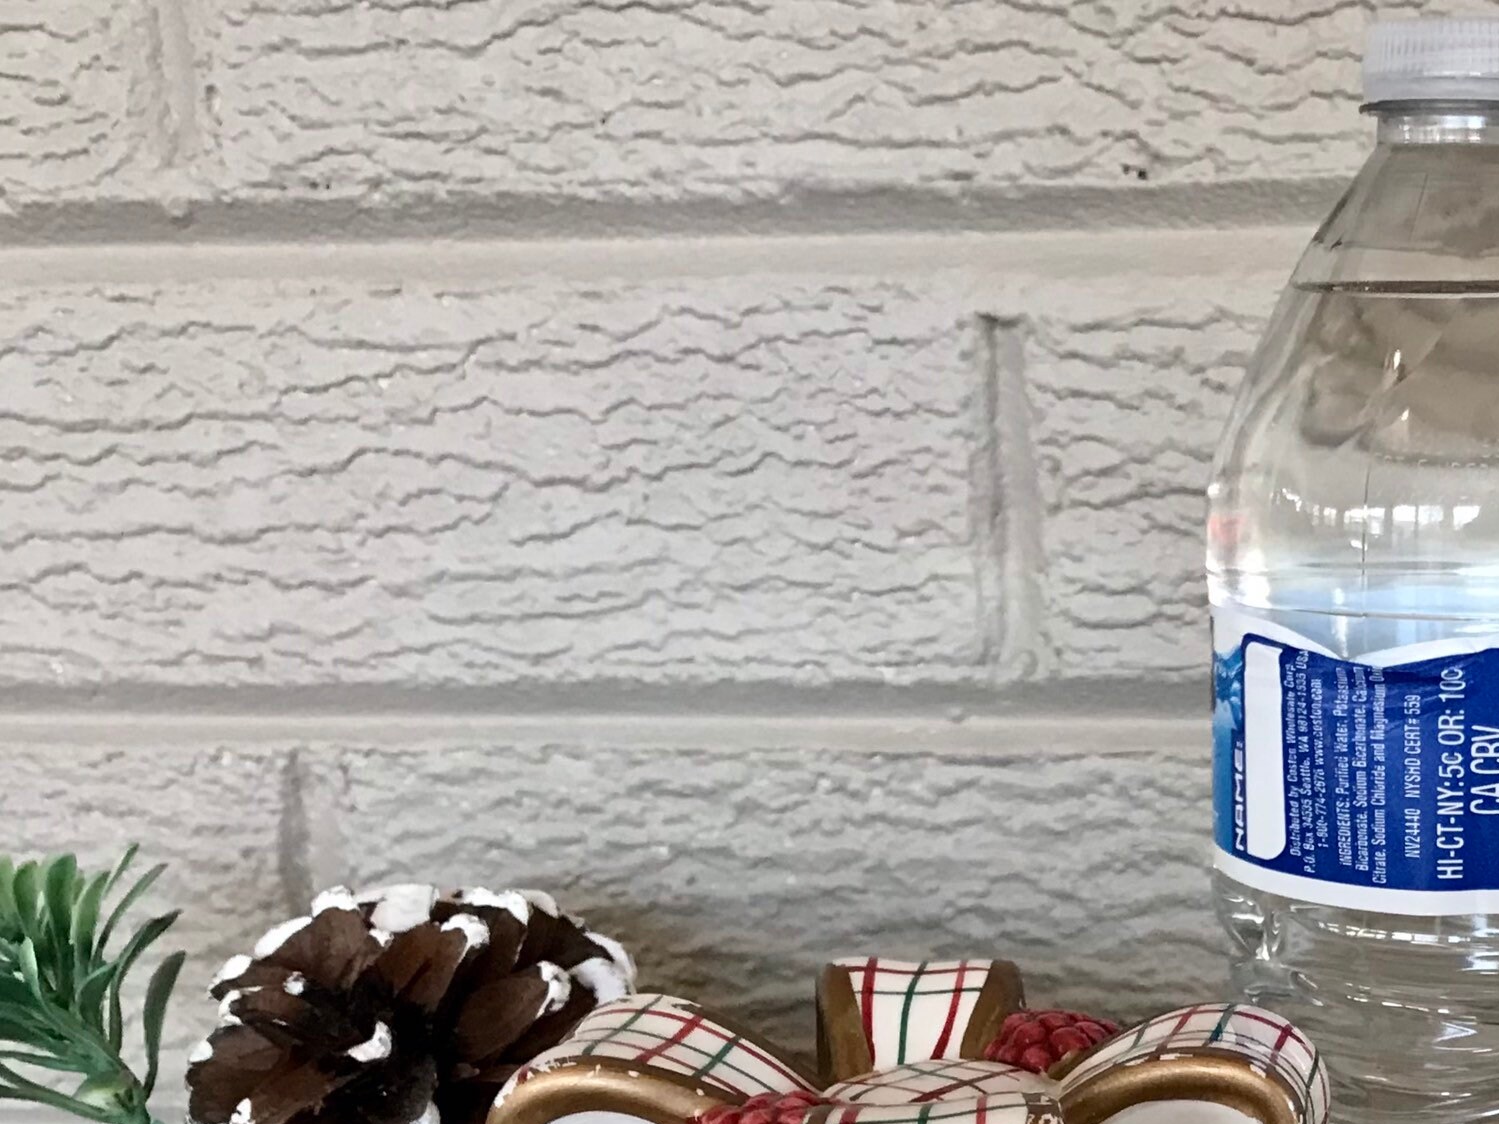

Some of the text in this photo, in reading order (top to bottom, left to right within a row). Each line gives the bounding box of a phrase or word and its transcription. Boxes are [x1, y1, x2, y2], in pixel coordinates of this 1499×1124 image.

[1332, 667, 1349, 717] Potassium
[1370, 683, 1388, 740] Magnesium
[1285, 691, 1296, 744] Wholesale
[1438, 710, 1465, 746] OR:
[1298, 736, 1309, 753] WA
[1370, 743, 1385, 762] and
[1288, 785, 1300, 798] by
[1334, 756, 1350, 795] Purified
[1352, 770, 1368, 808] Sodium
[1370, 764, 1386, 806] Chloride
[1404, 694, 1420, 858] NV24440 NYSHD CERT# 559
[1234, 742, 1244, 851] NAME:
[1289, 800, 1301, 856] Distributed
[1302, 832, 1314, 850] Box
[1336, 798, 1352, 866] INGREDIENTS:
[1371, 809, 1386, 846] Sodium
